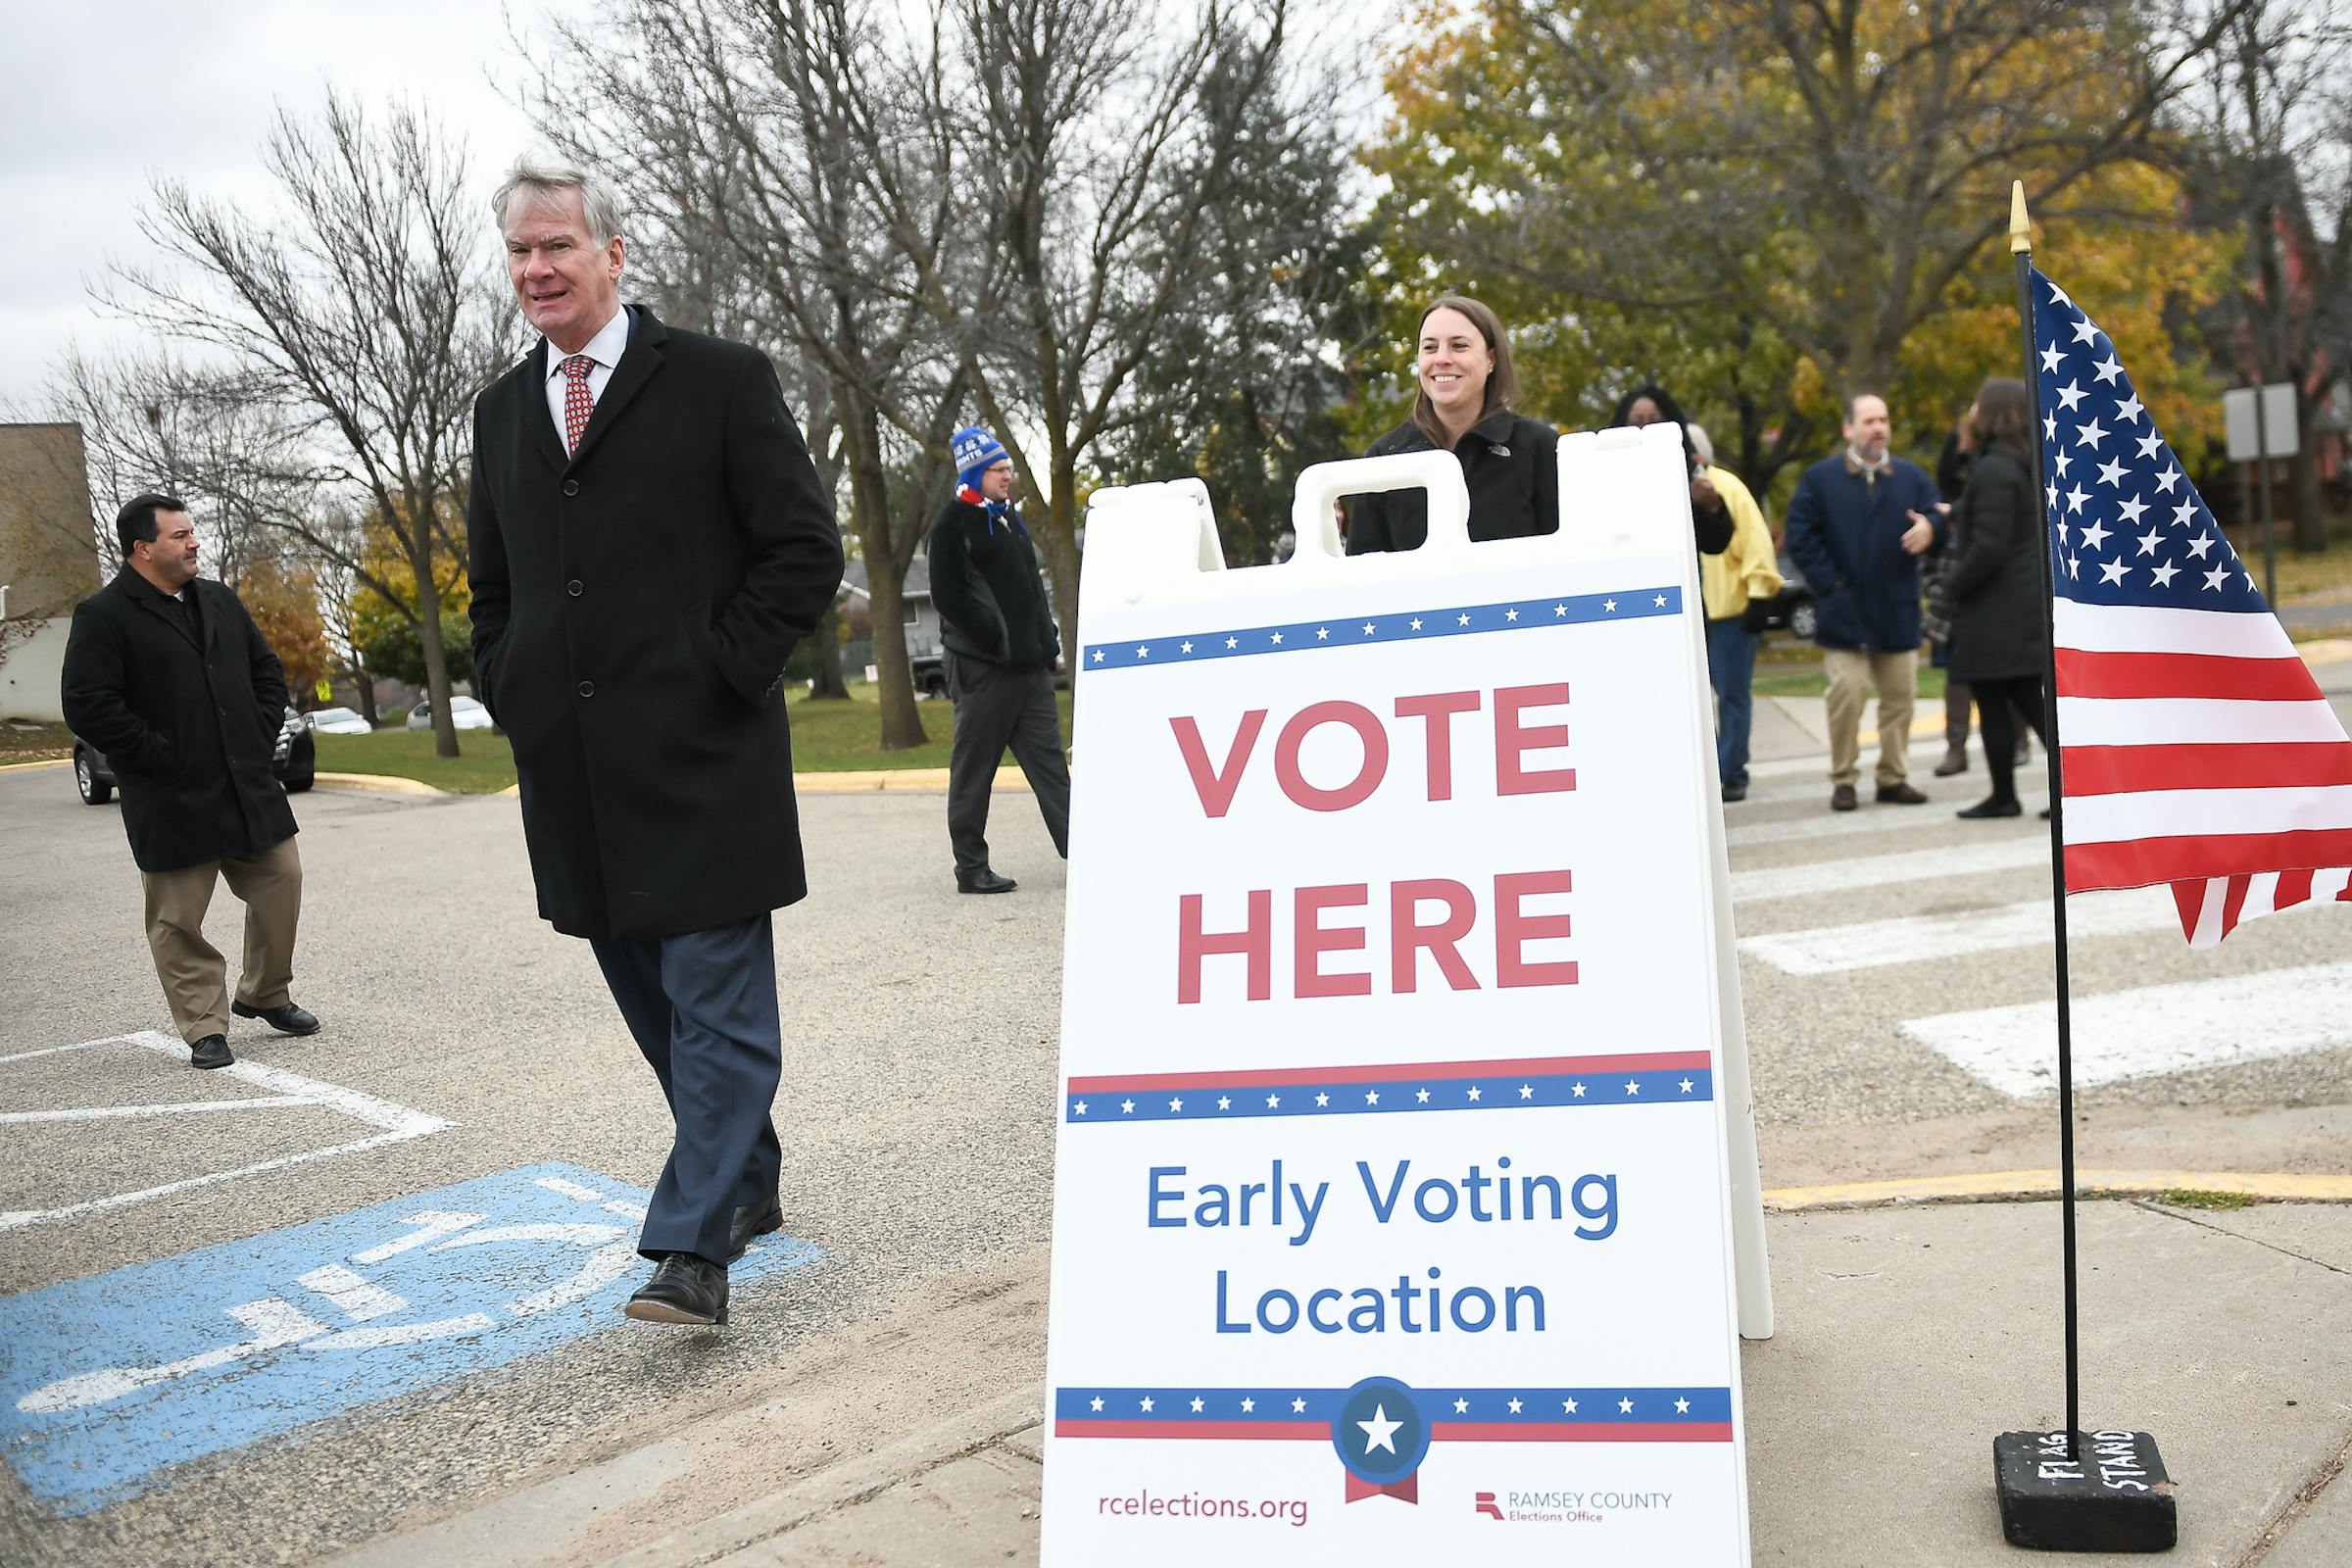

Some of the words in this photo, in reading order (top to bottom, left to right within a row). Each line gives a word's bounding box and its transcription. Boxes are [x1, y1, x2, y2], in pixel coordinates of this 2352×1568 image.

[1168, 682, 1578, 819] VOTE
[1177, 869, 1580, 1004] HERE
[1147, 1159, 1331, 1247] Early
[1355, 1156, 1619, 1242] Voting
[1215, 1266, 1546, 1335] Location
[2091, 1430, 2150, 1491] STAND
[1099, 1488, 1307, 1527] rcelections.org
[1509, 1492, 1585, 1508] RAMSEY
[1590, 1492, 1673, 1509] COUNTY
[1509, 1510, 1563, 1522] Elections
[1566, 1510, 1603, 1522] Office
